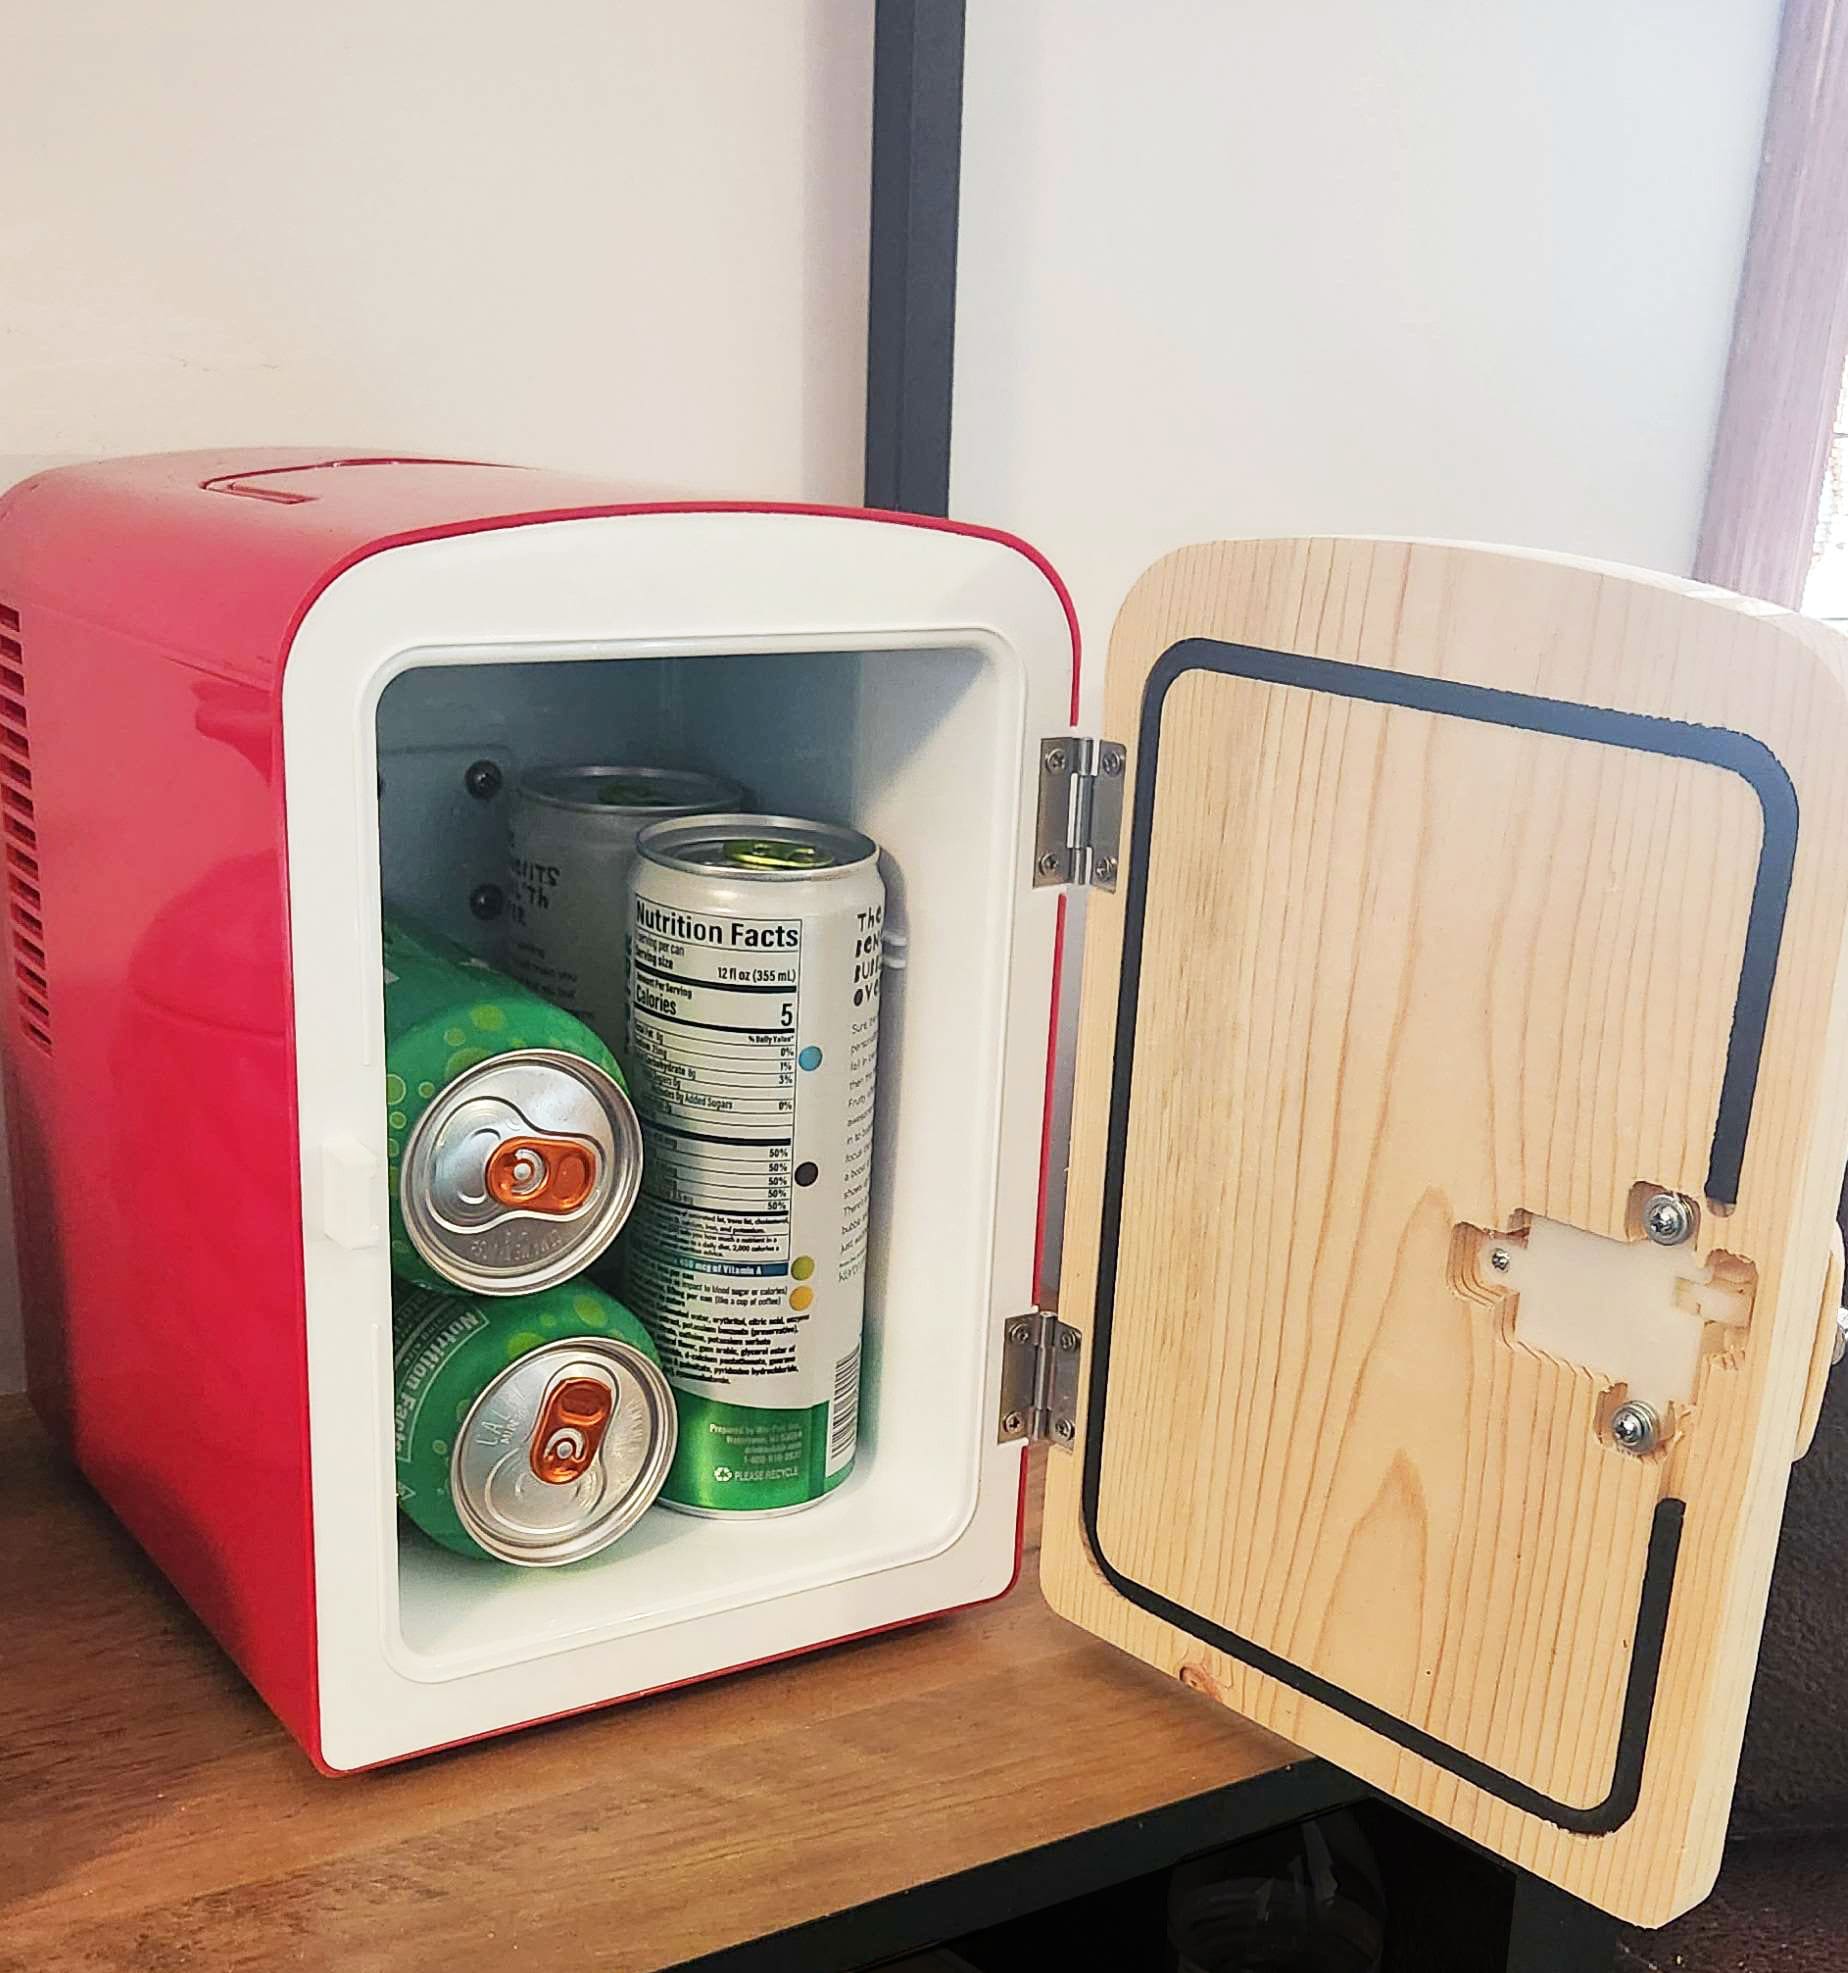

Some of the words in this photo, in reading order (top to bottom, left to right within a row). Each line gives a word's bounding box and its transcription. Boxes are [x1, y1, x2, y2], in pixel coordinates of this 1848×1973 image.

[636, 900, 723, 945] Nutrition
[731, 922, 799, 948] Facts
[671, 944, 685, 958] can
[659, 954, 674, 970] size
[717, 967, 728, 981] 12
[729, 967, 737, 981] fl
[739, 972, 750, 981] oz
[752, 970, 776, 983] (355
[778, 969, 797, 983] mL)
[665, 982, 693, 1000] Serving
[636, 984, 677, 1016] Calories
[780, 1002, 793, 1027] 5
[756, 1036, 772, 1045] Daily
[780, 1048, 794, 1058] 0%
[779, 1062, 792, 1072] 1%
[778, 1074, 793, 1085] 3%
[707, 1096, 733, 1112] Sugars
[769, 1148, 789, 1158] 50%
[768, 1163, 788, 1173] 50%
[767, 1177, 788, 1187] 50%
[767, 1190, 787, 1199] 50%
[767, 1202, 786, 1211] 50%
[712, 1264, 722, 1274] of
[723, 1264, 754, 1275] Vitamin
[756, 1265, 762, 1275] A
[712, 1286, 730, 1295] blood
[760, 1286, 787, 1296] calories)
[405, 1311, 481, 1392] Nutrition
[734, 1471, 764, 1482] PLEASE
